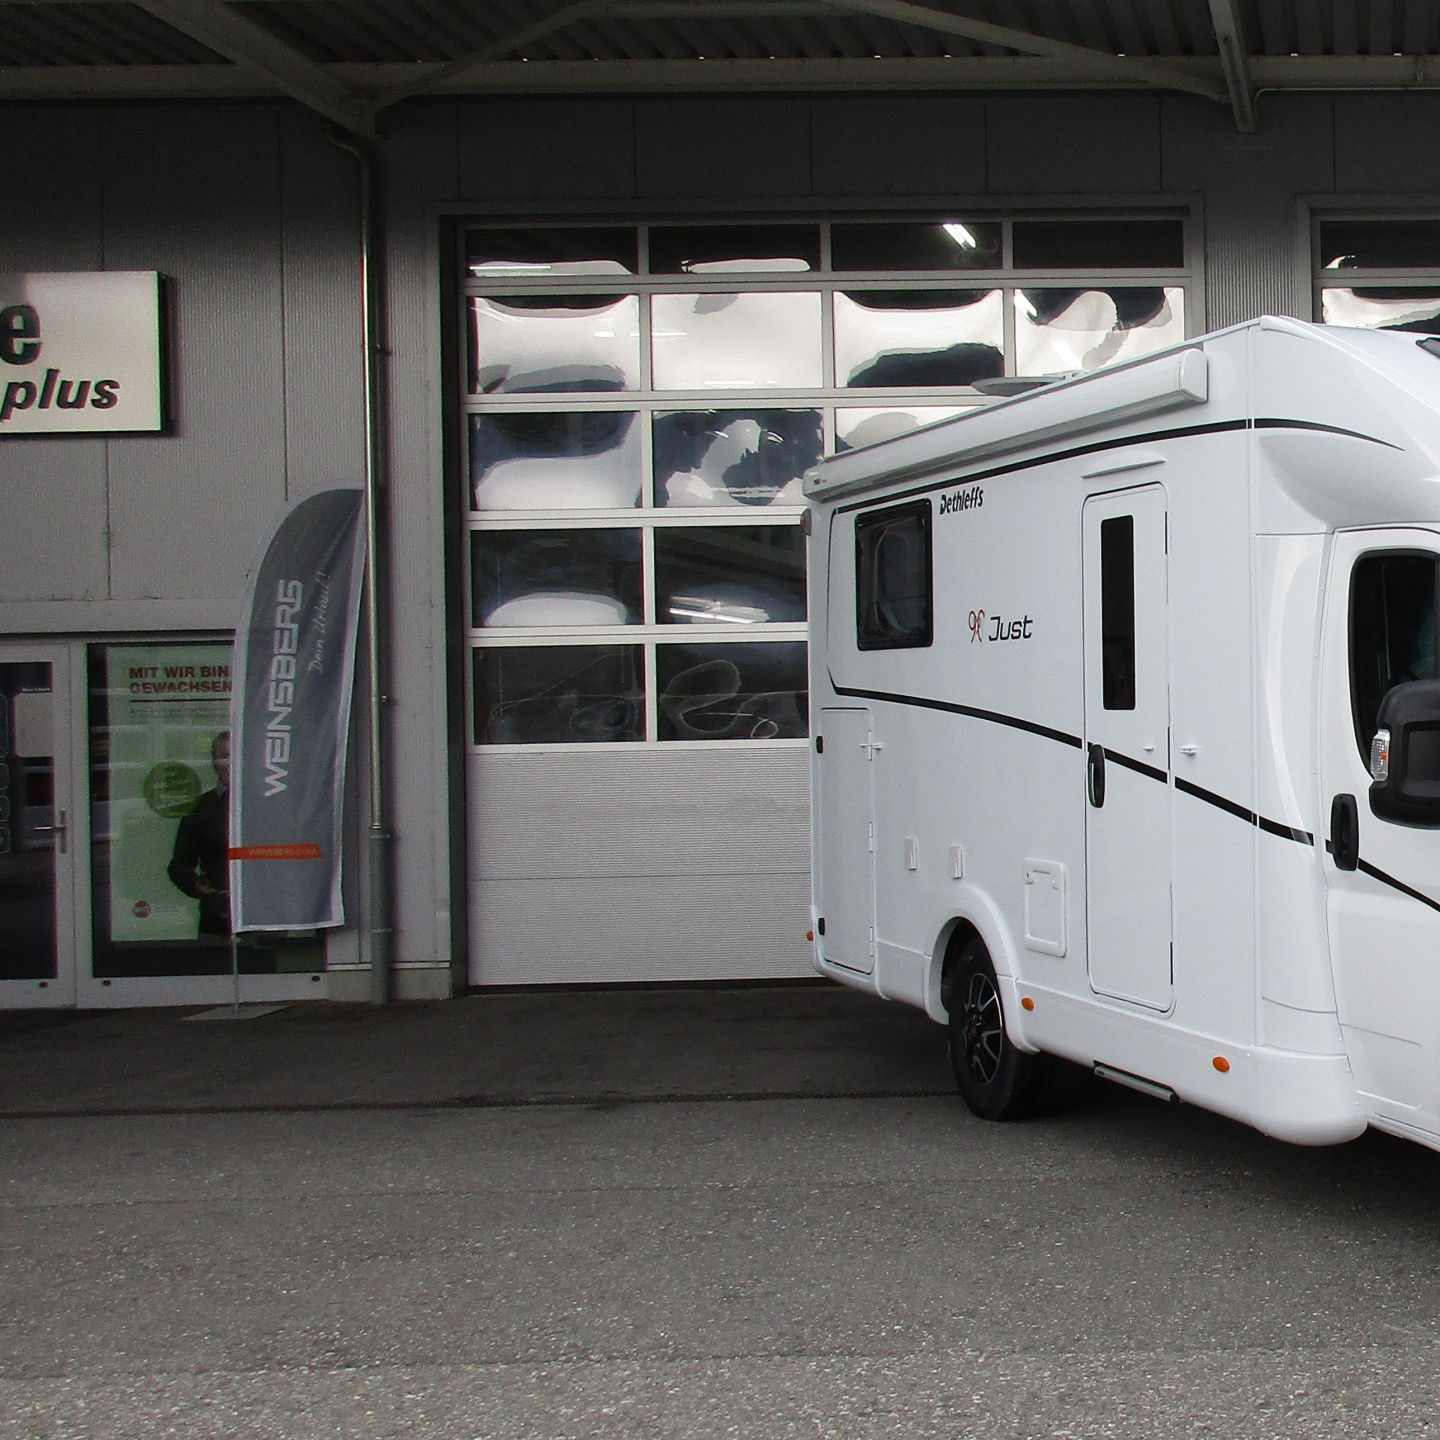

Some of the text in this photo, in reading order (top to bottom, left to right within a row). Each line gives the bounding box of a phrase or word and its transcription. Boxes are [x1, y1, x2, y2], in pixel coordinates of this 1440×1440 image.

[0, 368, 120, 421] plus
[939, 486, 984, 515] Dethleffs
[988, 615, 1033, 641] Just
[129, 667, 159, 678] MIT
[164, 666, 195, 678] WIR
[130, 681, 232, 694] GEWACHSEN
[264, 579, 303, 797] WEINSBERG
